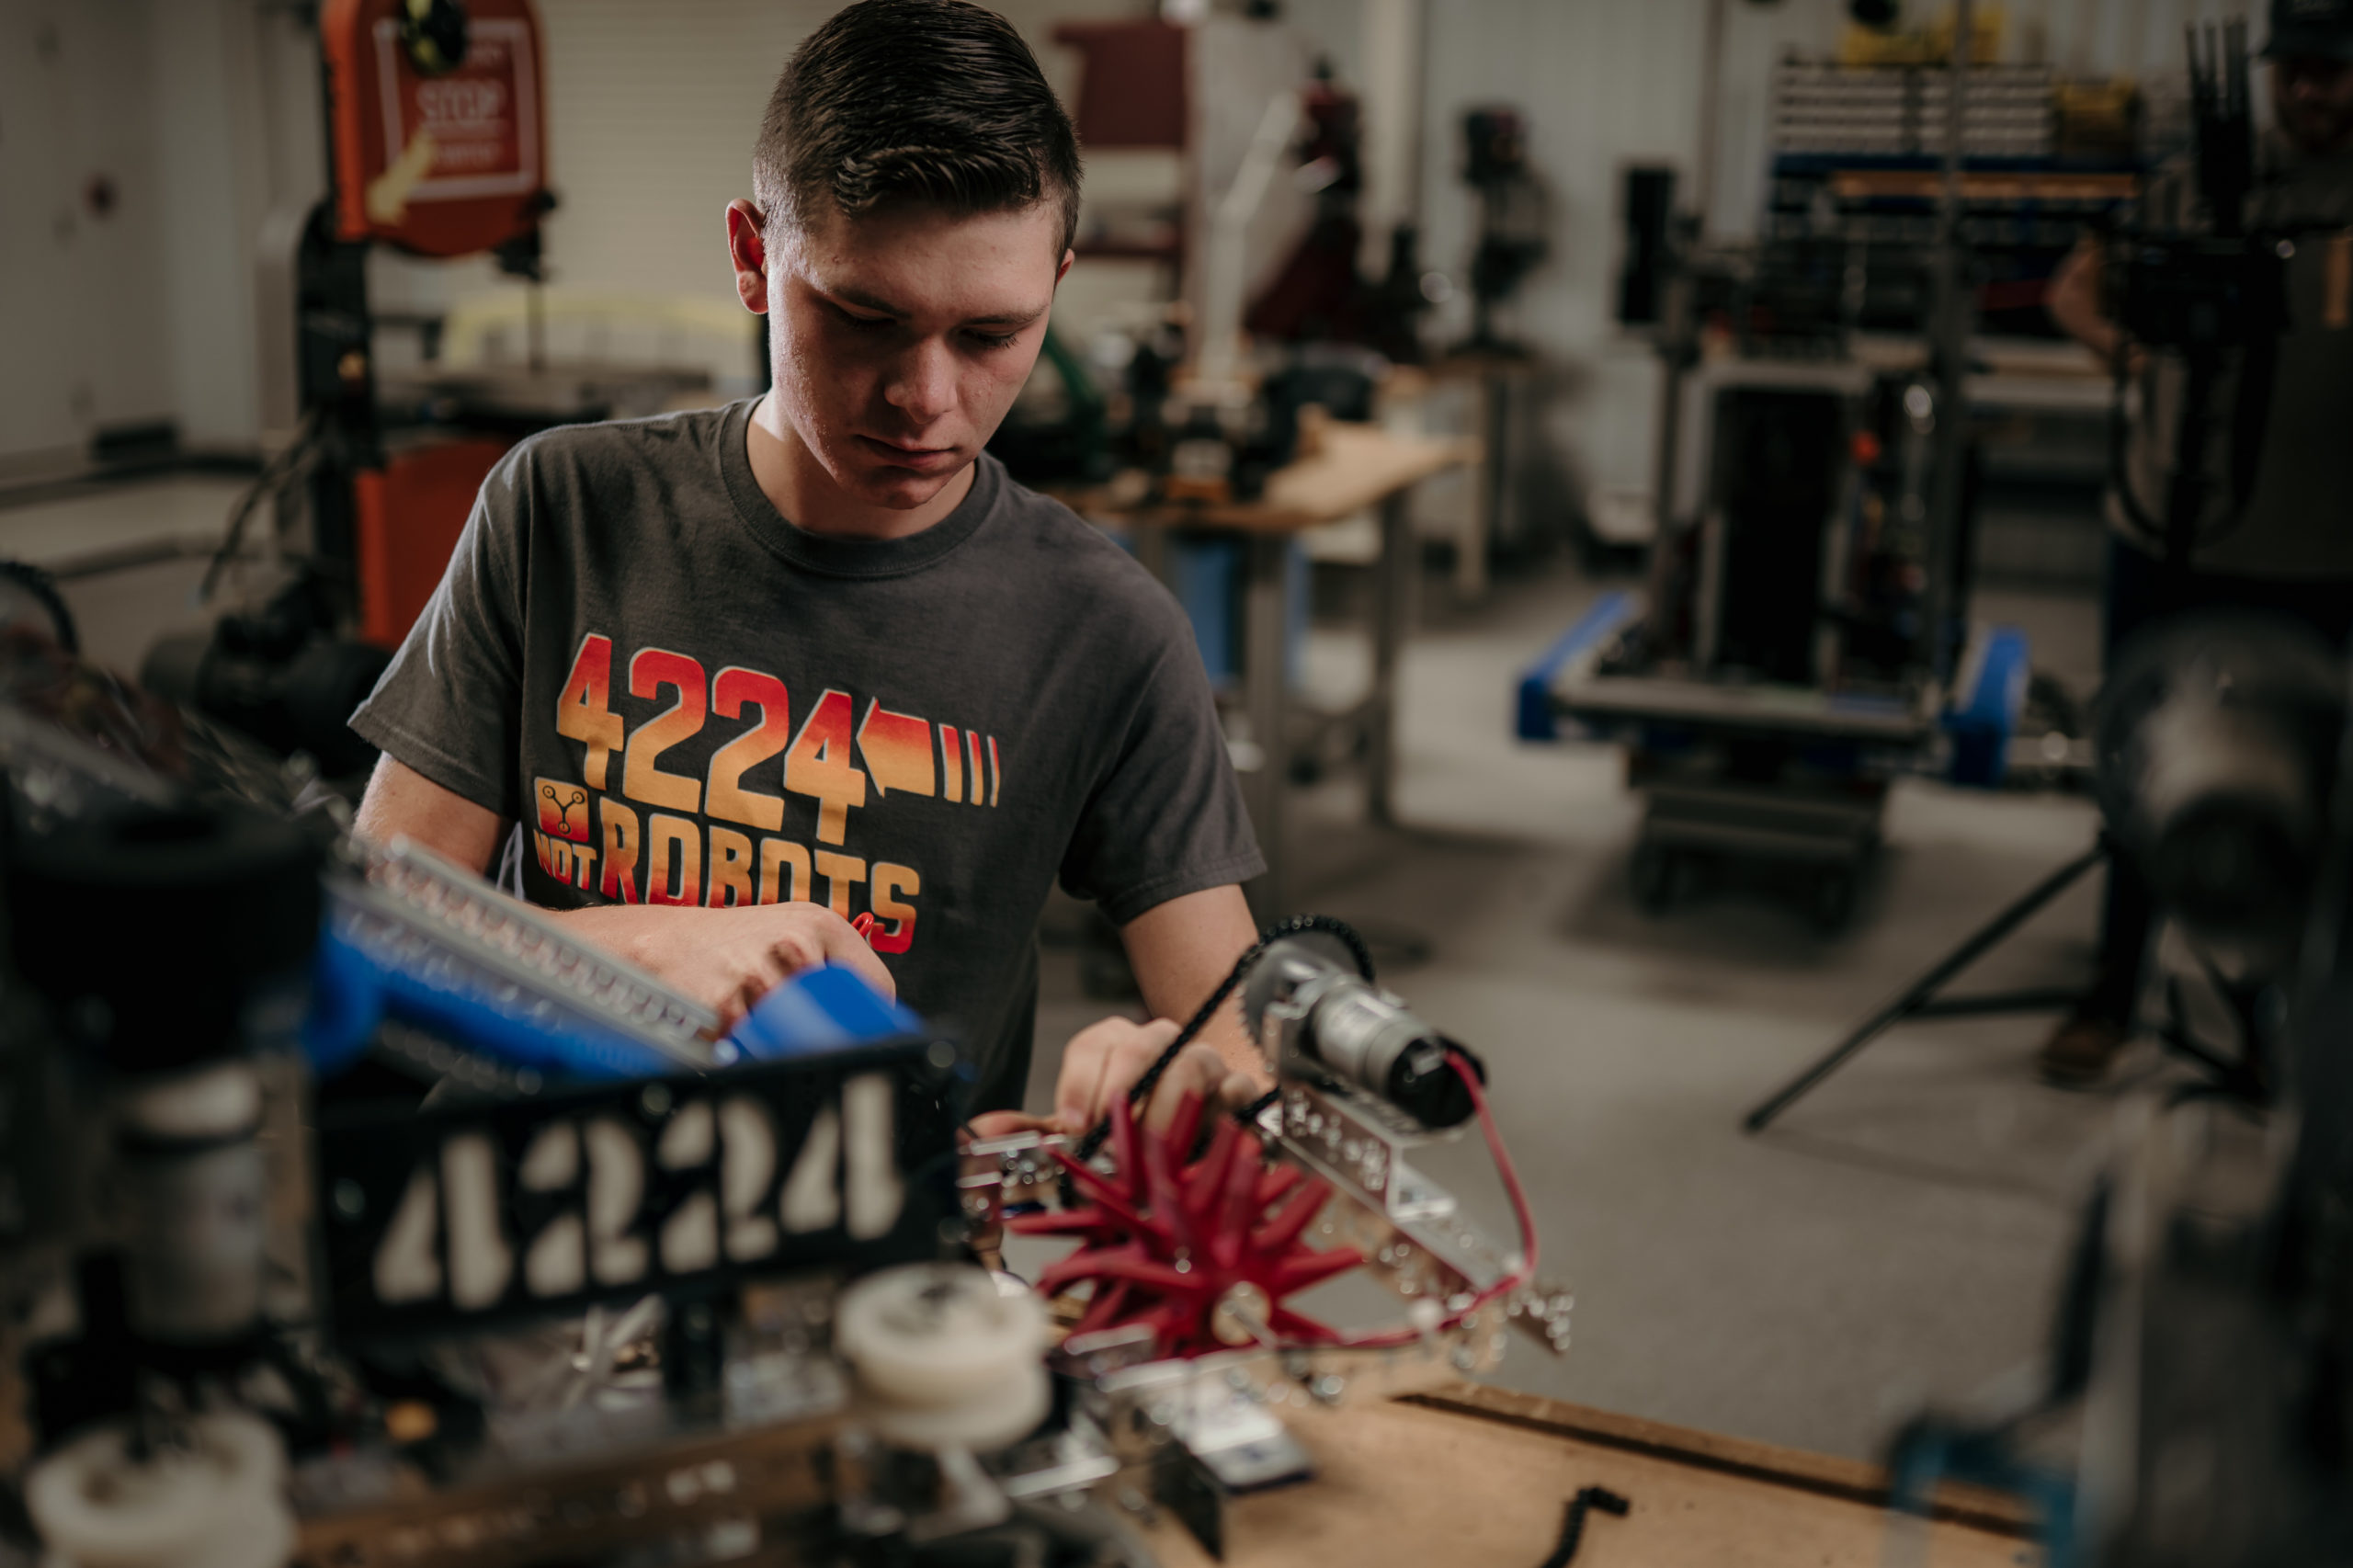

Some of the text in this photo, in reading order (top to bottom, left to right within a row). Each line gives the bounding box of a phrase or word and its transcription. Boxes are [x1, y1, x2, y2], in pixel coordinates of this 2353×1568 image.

[417, 80, 503, 125] STOP
[556, 632, 866, 846] 4224
[534, 796, 920, 954] NOT ROBOTS
[373, 1074, 904, 1310] 4224
